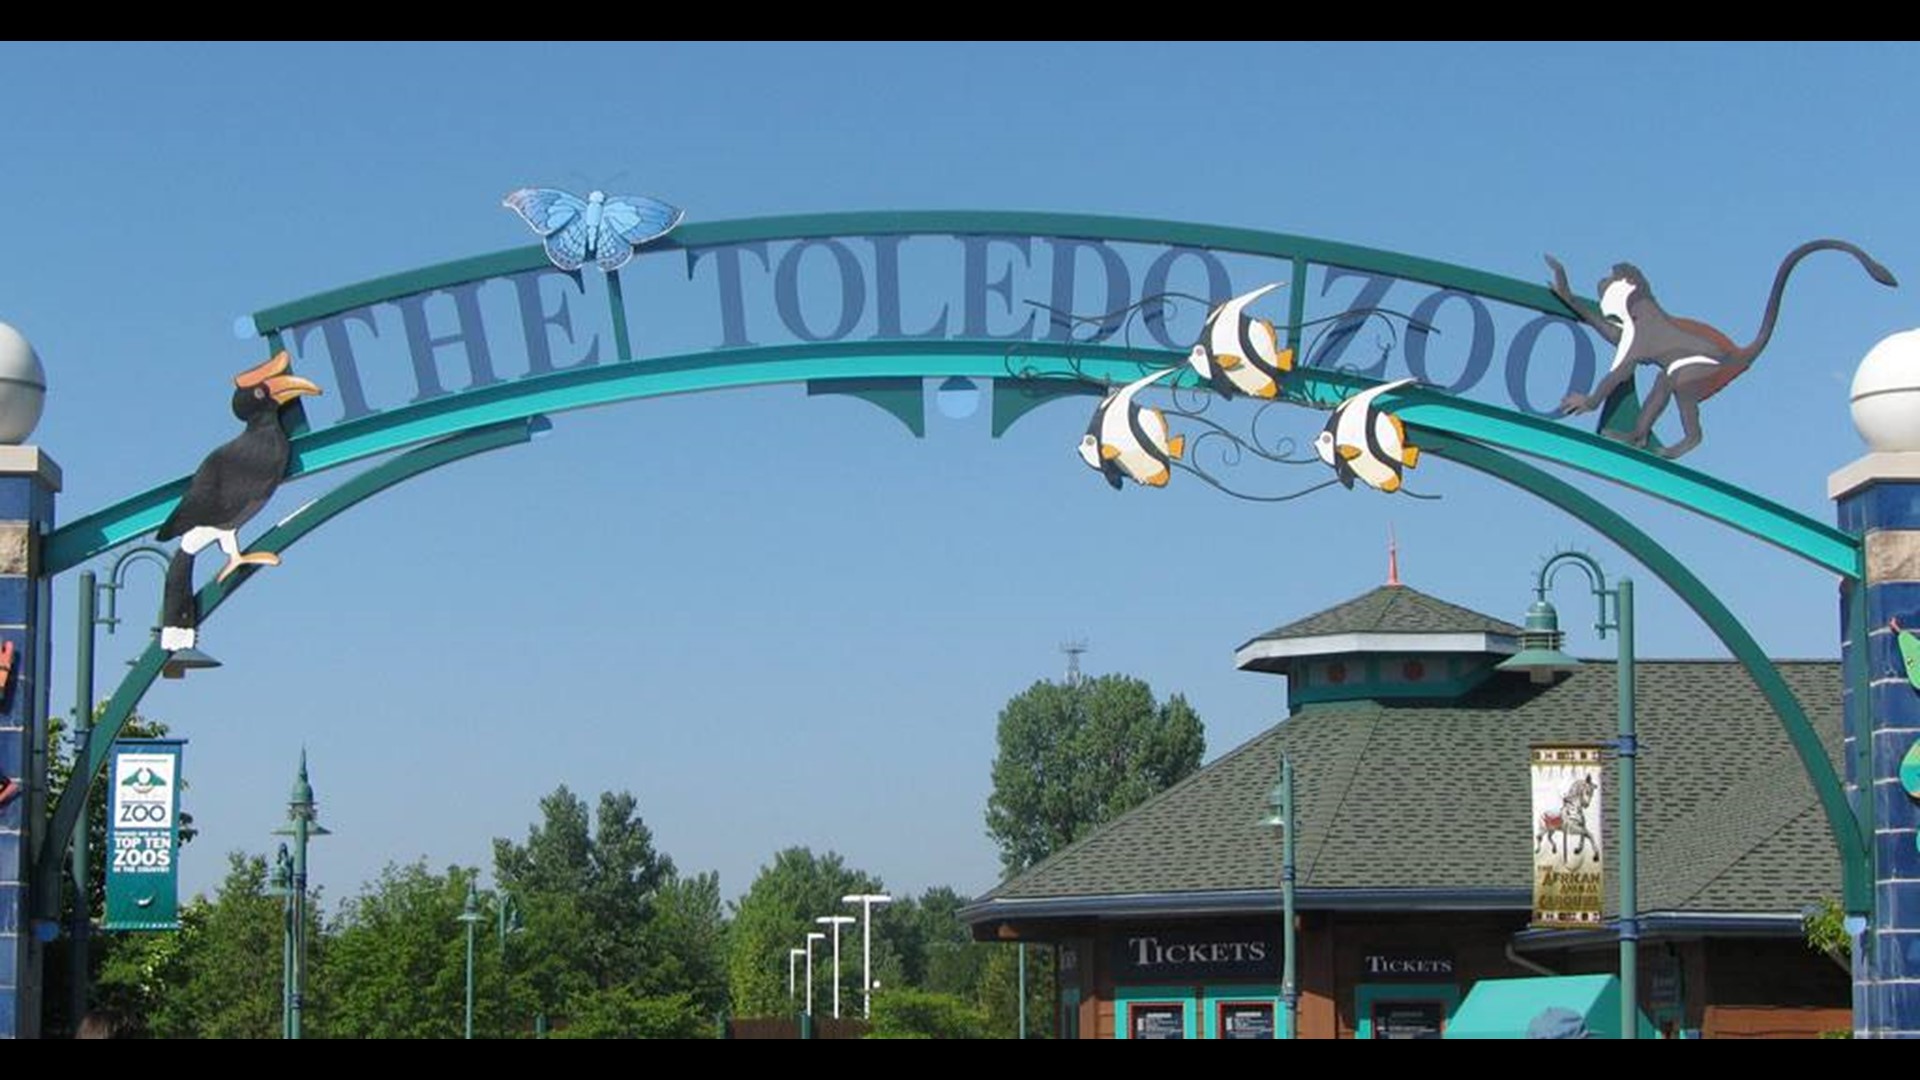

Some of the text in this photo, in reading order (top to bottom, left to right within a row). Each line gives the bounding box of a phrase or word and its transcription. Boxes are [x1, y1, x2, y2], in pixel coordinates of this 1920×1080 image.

[291, 233, 1597, 424] THE TOLEDO ZOO
[121, 805, 166, 822] ZOO
[115, 837, 171, 849] TOP TEN
[113, 849, 170, 867] ZOOS
[1542, 872, 1600, 886] AFRICAN
